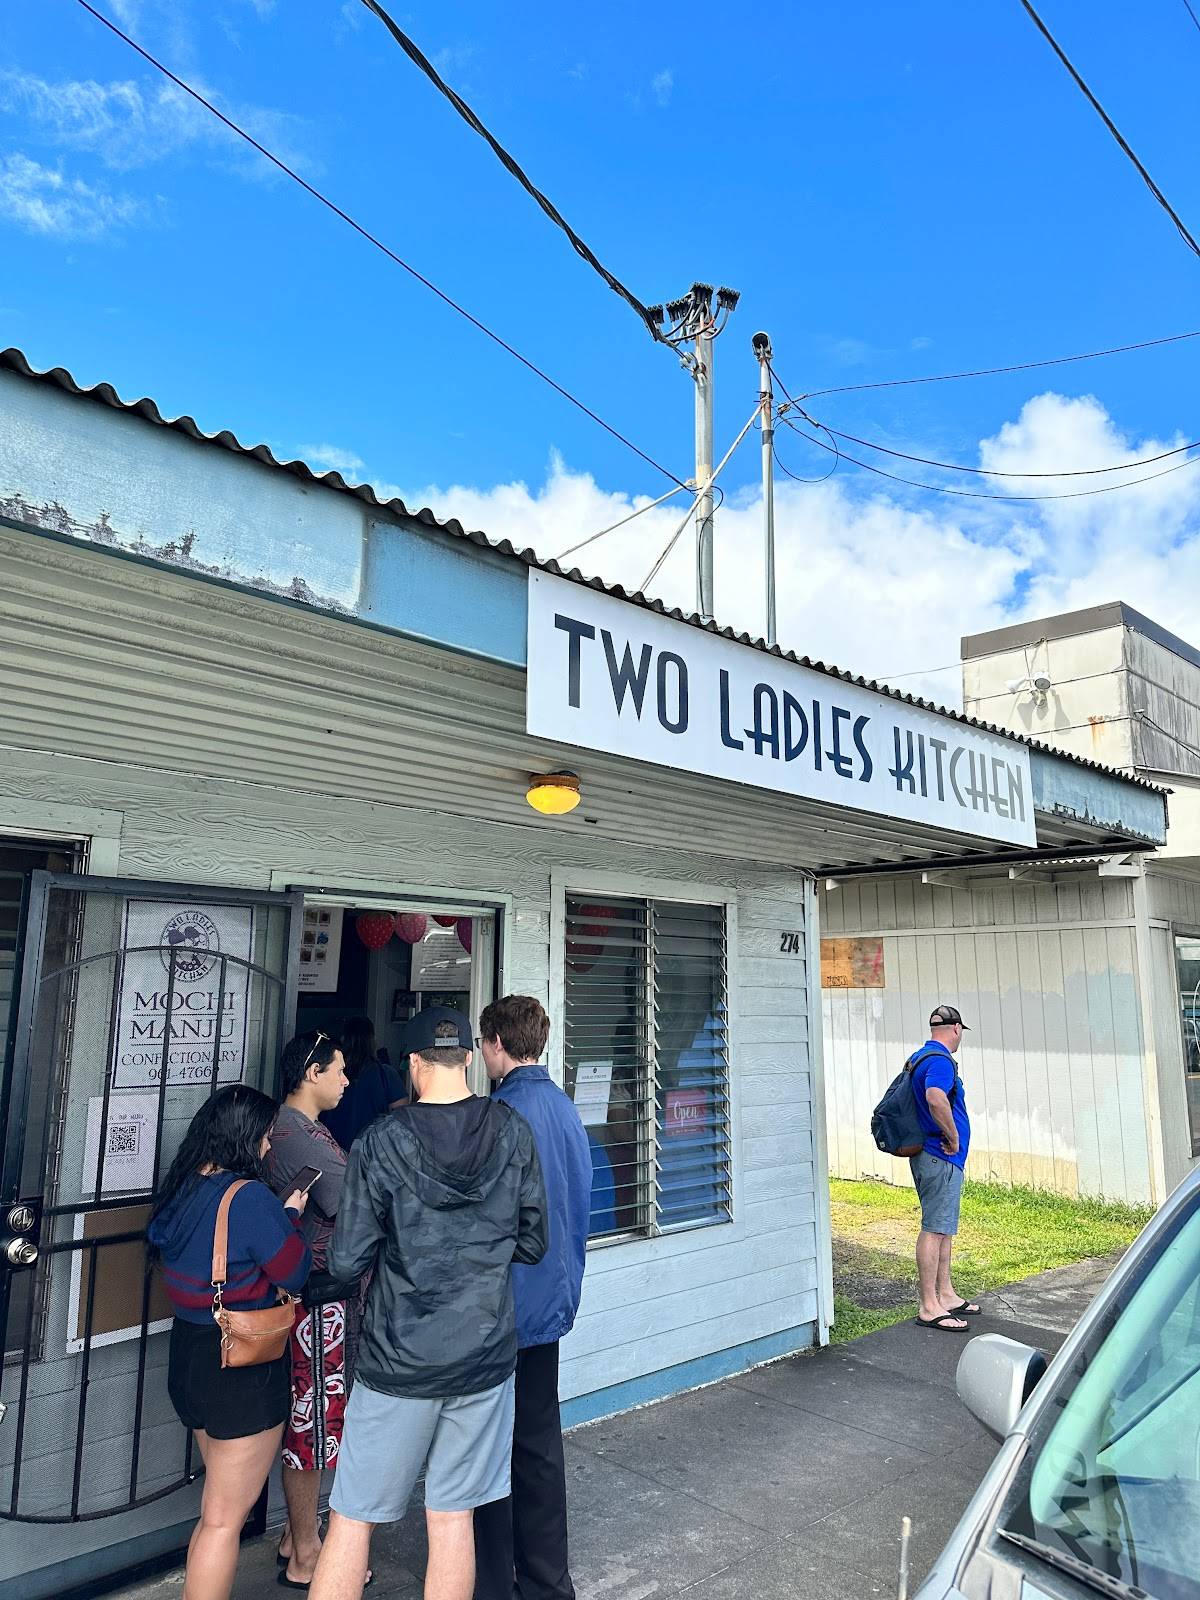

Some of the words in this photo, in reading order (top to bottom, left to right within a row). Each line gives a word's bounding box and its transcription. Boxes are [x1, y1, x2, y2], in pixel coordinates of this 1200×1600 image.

[554, 613, 688, 734] TWO
[719, 668, 873, 783] LADIES
[888, 725, 1025, 823] KITCHEN
[780, 932, 800, 954] 274
[132, 991, 235, 1011] MOCHI
[129, 1018, 236, 1039] MANJU
[121, 1050, 239, 1066] CONFCTIONRY
[673, 1100, 698, 1128] Open
